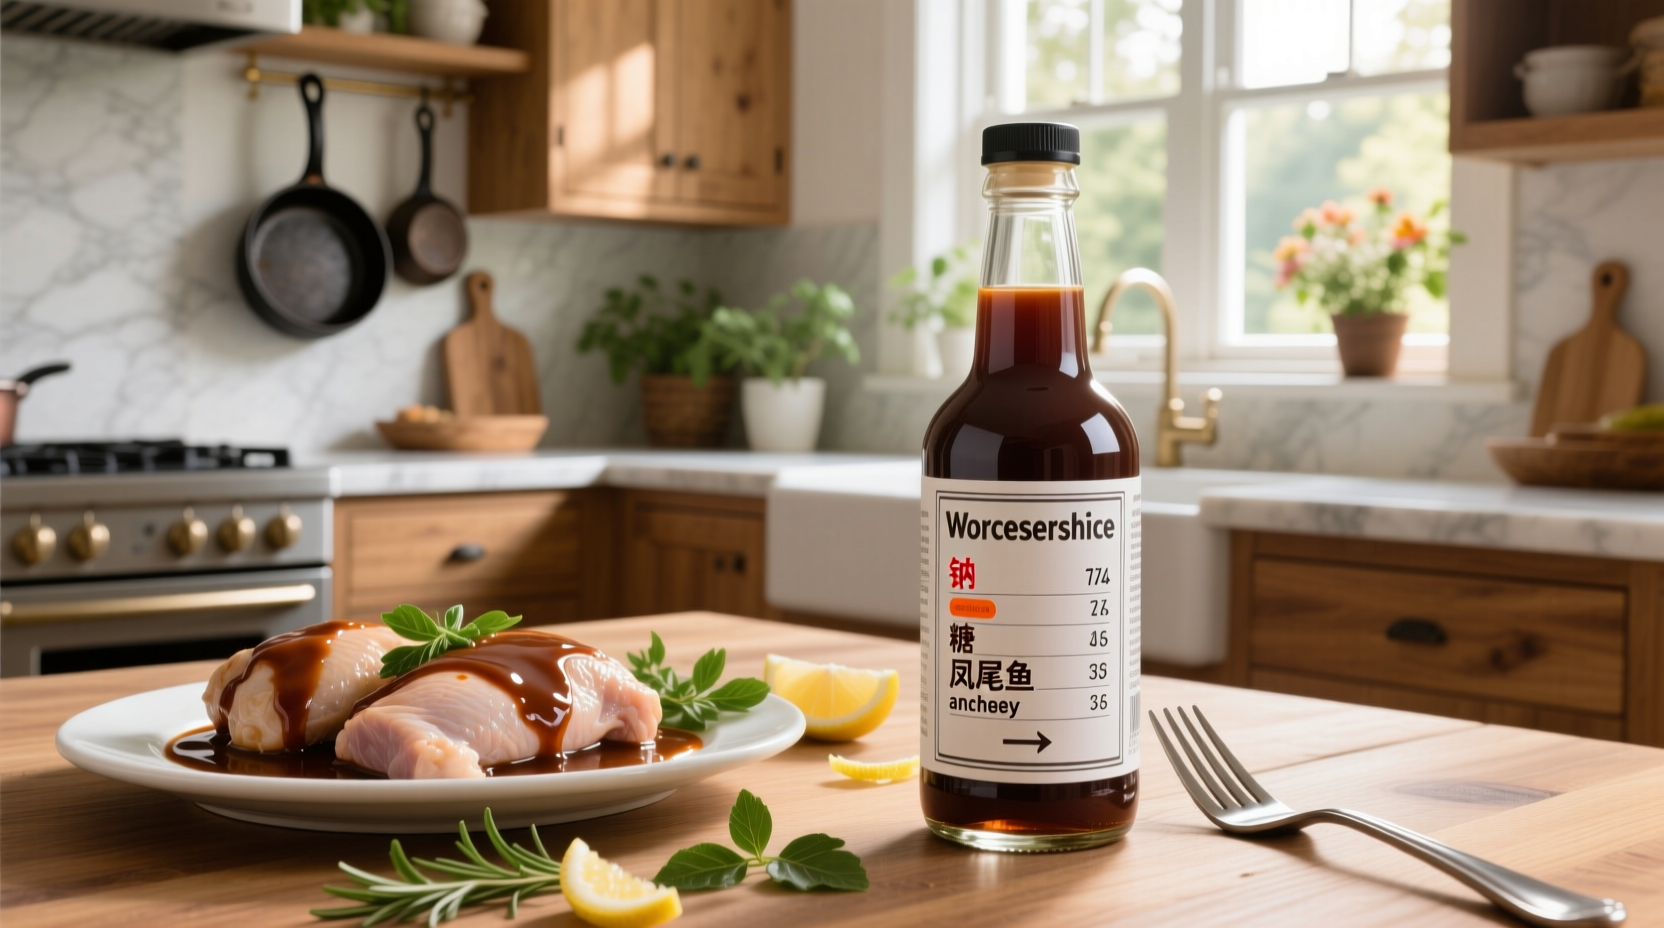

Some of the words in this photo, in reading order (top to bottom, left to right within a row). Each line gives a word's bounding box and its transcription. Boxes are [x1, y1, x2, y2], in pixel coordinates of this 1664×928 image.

[945, 511, 1115, 541] Worcesershice
[949, 557, 975, 589] 钠
[949, 623, 975, 654] 糖
[949, 659, 1035, 691] 凤尾鱼
[1090, 694, 1108, 710] 36
